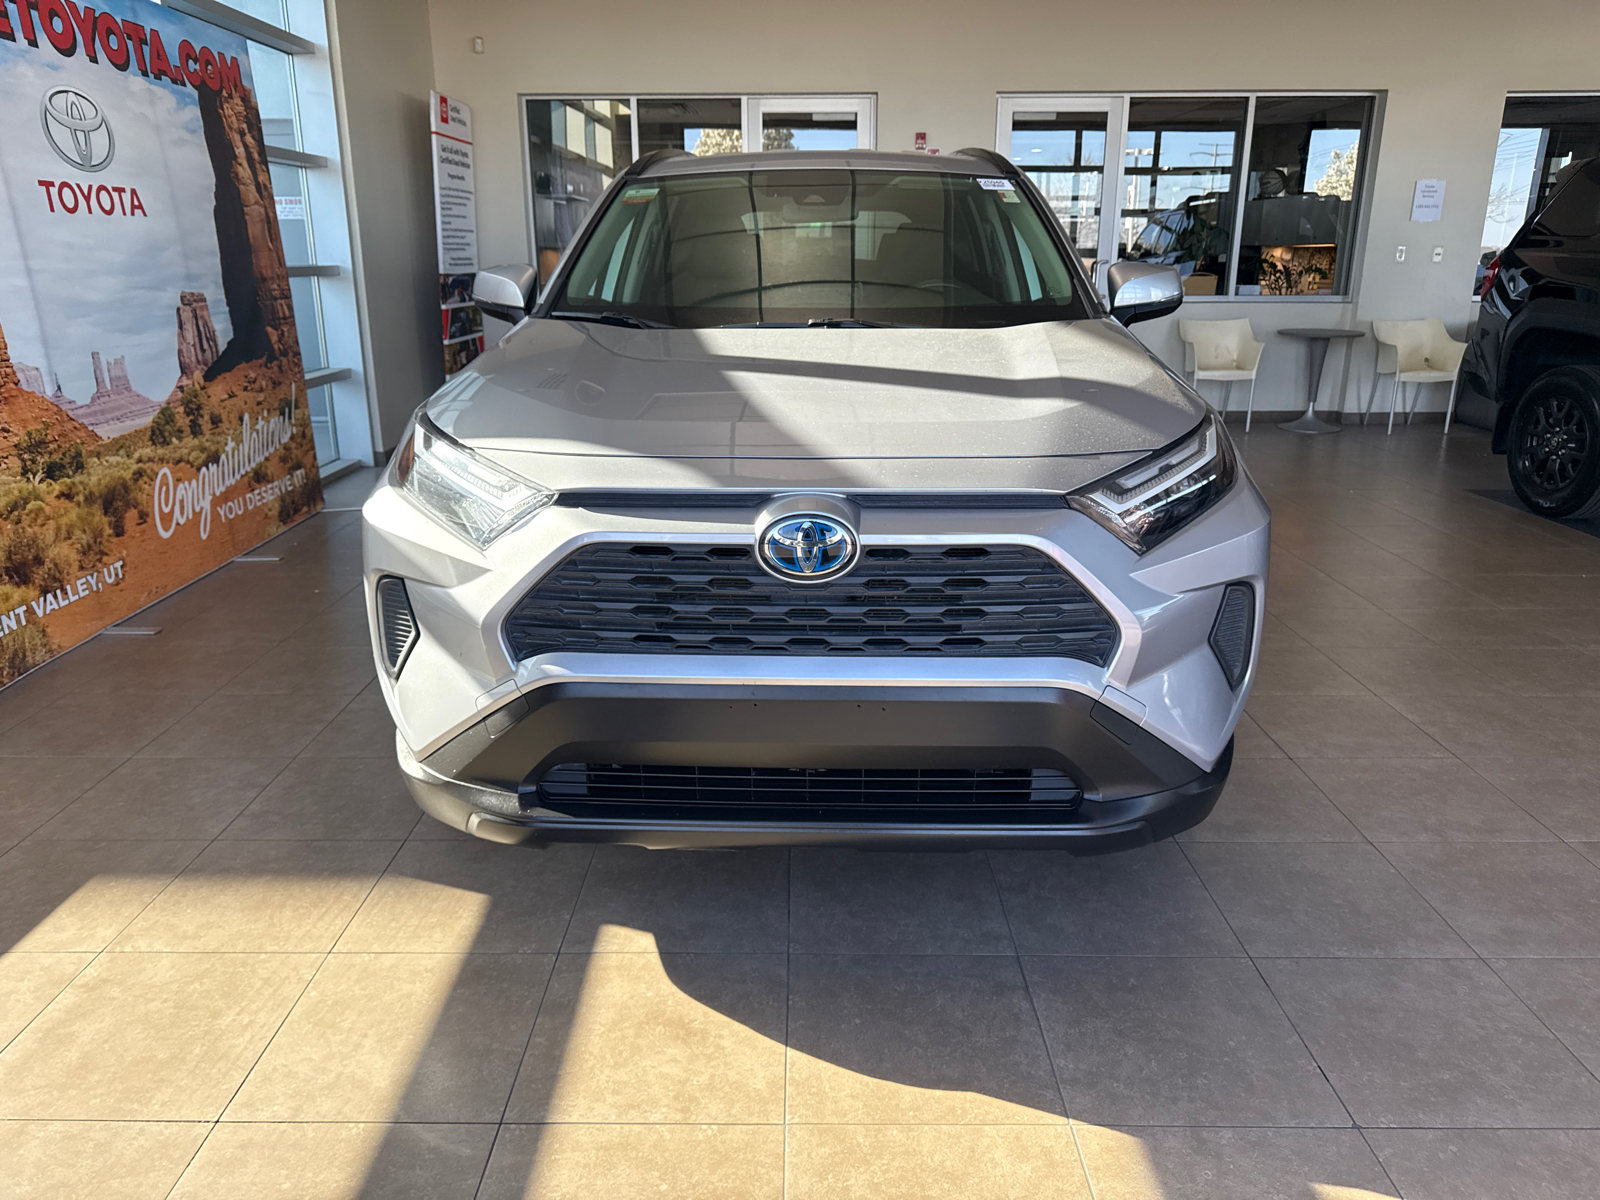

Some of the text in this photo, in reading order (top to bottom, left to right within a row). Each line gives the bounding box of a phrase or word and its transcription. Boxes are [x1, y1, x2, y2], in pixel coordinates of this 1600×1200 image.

[37, 179, 148, 217] TOYOTA
[154, 382, 297, 539] Congratulations!
[217, 467, 307, 522] YOU DESERVE IT!
[0, 560, 123, 638] NT VALLEY, UT
